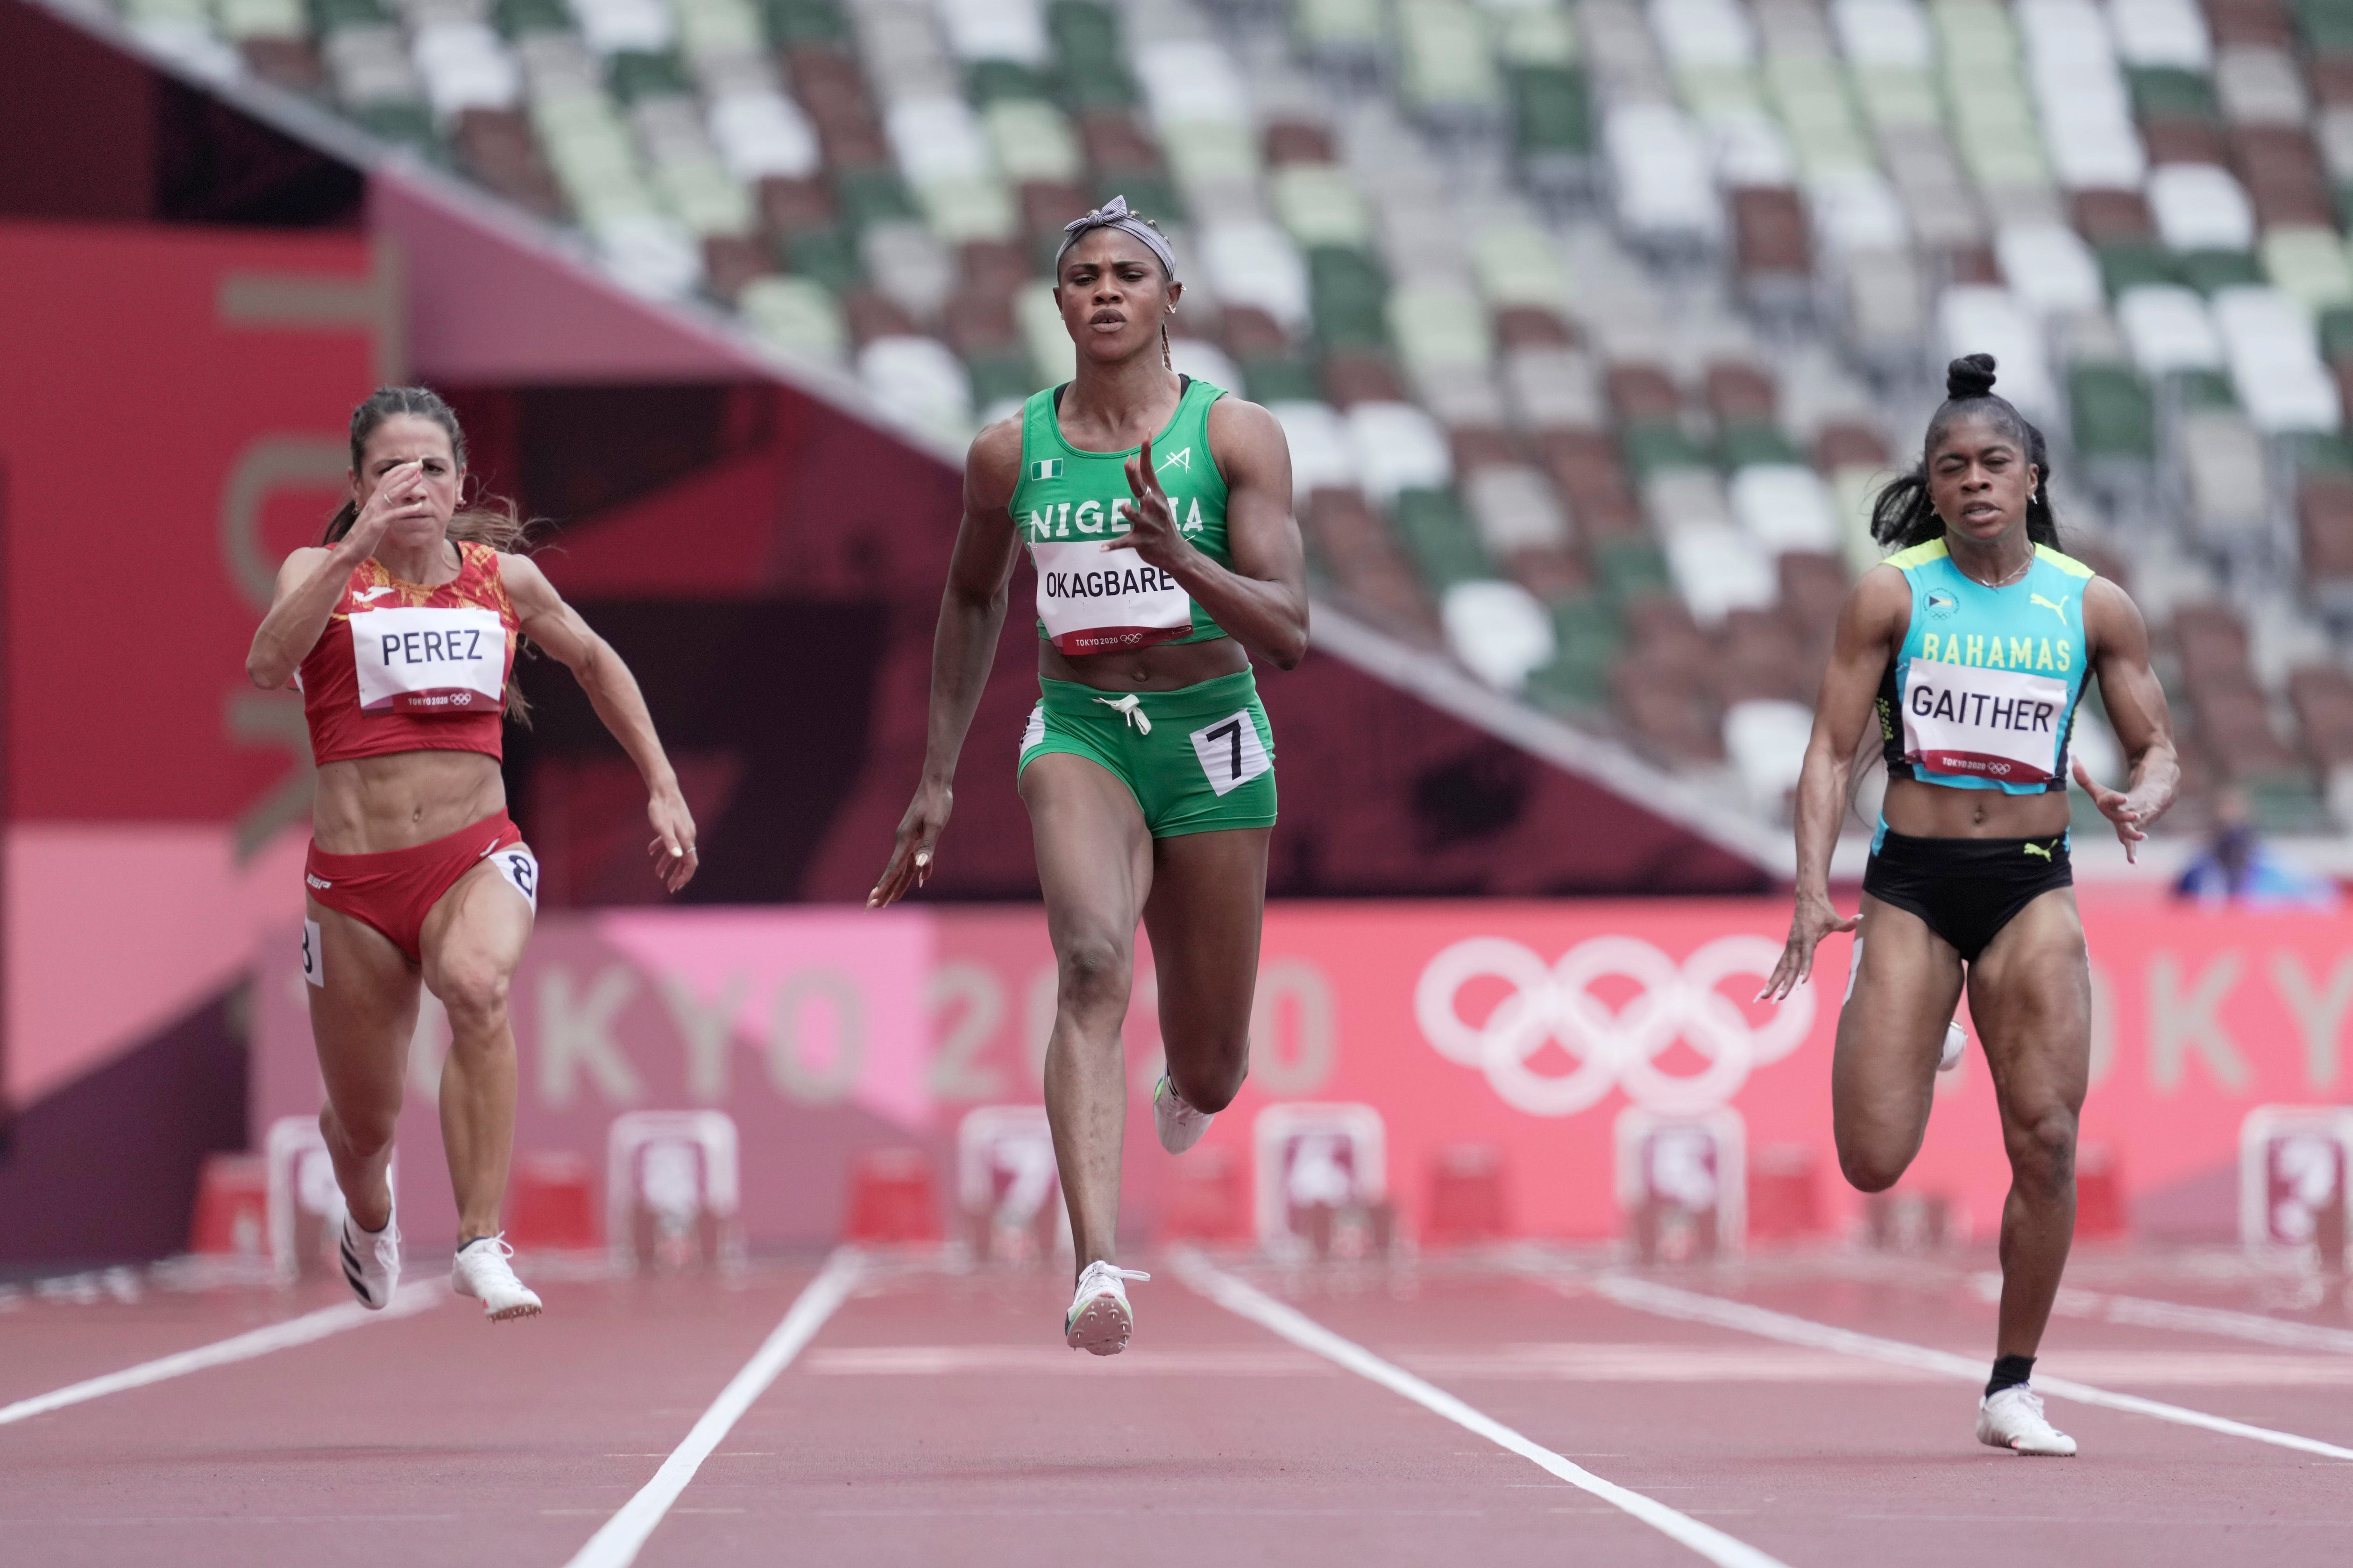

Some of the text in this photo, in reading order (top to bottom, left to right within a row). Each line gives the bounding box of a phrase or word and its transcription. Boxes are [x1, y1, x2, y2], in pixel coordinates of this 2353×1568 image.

[1031, 497, 1204, 543] NIGEIA
[1047, 567, 1174, 598] OKAGBARE
[382, 630, 482, 665] PEREZ
[1923, 633, 2070, 671] BAHAMAS
[408, 696, 448, 706] TOKYO 2020
[1912, 685, 2054, 732] GAITHER
[1205, 719, 1241, 780] 7
[1942, 757, 1986, 770] TOKYO 2020
[307, 873, 332, 889] ESP
[509, 855, 532, 898] 8
[921, 959, 1335, 1100] 20
